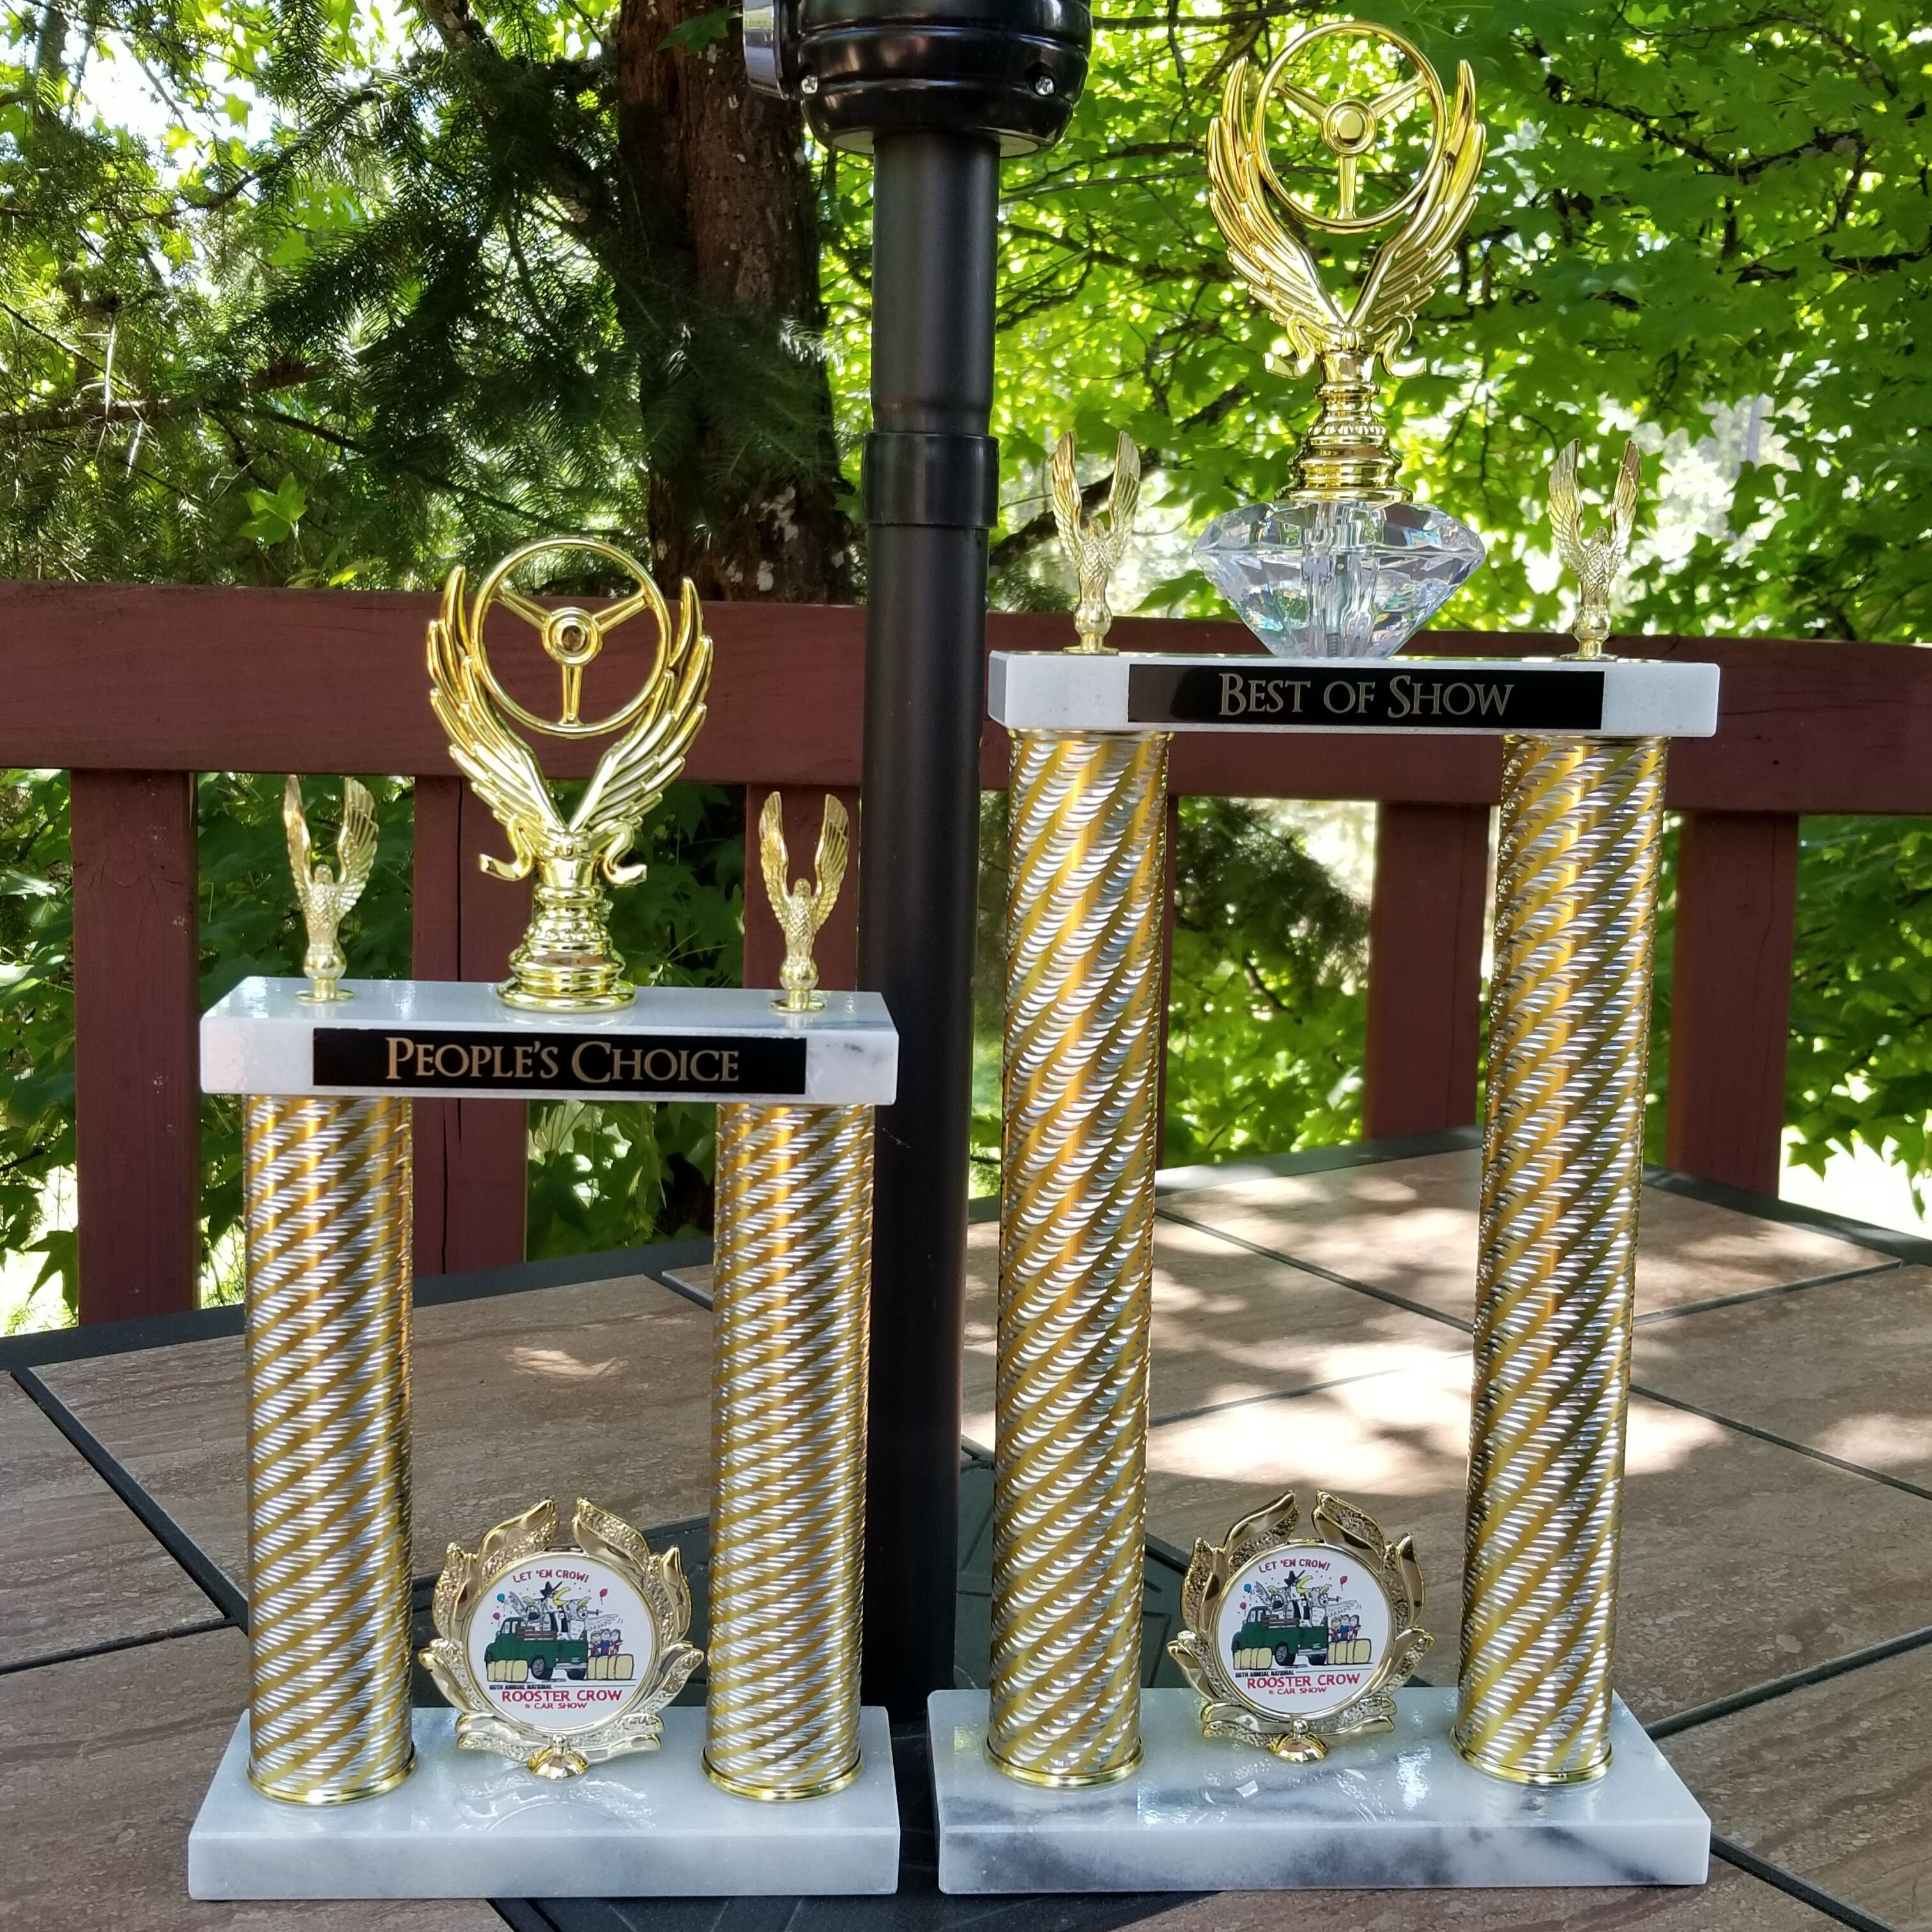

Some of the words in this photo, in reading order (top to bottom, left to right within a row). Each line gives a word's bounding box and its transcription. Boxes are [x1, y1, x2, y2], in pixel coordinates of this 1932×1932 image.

[1259, 1561, 1277, 1573] LET
[1299, 1559, 1330, 1570] CROW!
[512, 1571, 532, 1583] LET
[556, 1570, 589, 1583] CROW!
[1247, 1676, 1312, 1689] ROOSTER
[1317, 1673, 1361, 1685] CROW
[502, 1690, 570, 1702] ROOSTER
[577, 1690, 623, 1701] CROW
